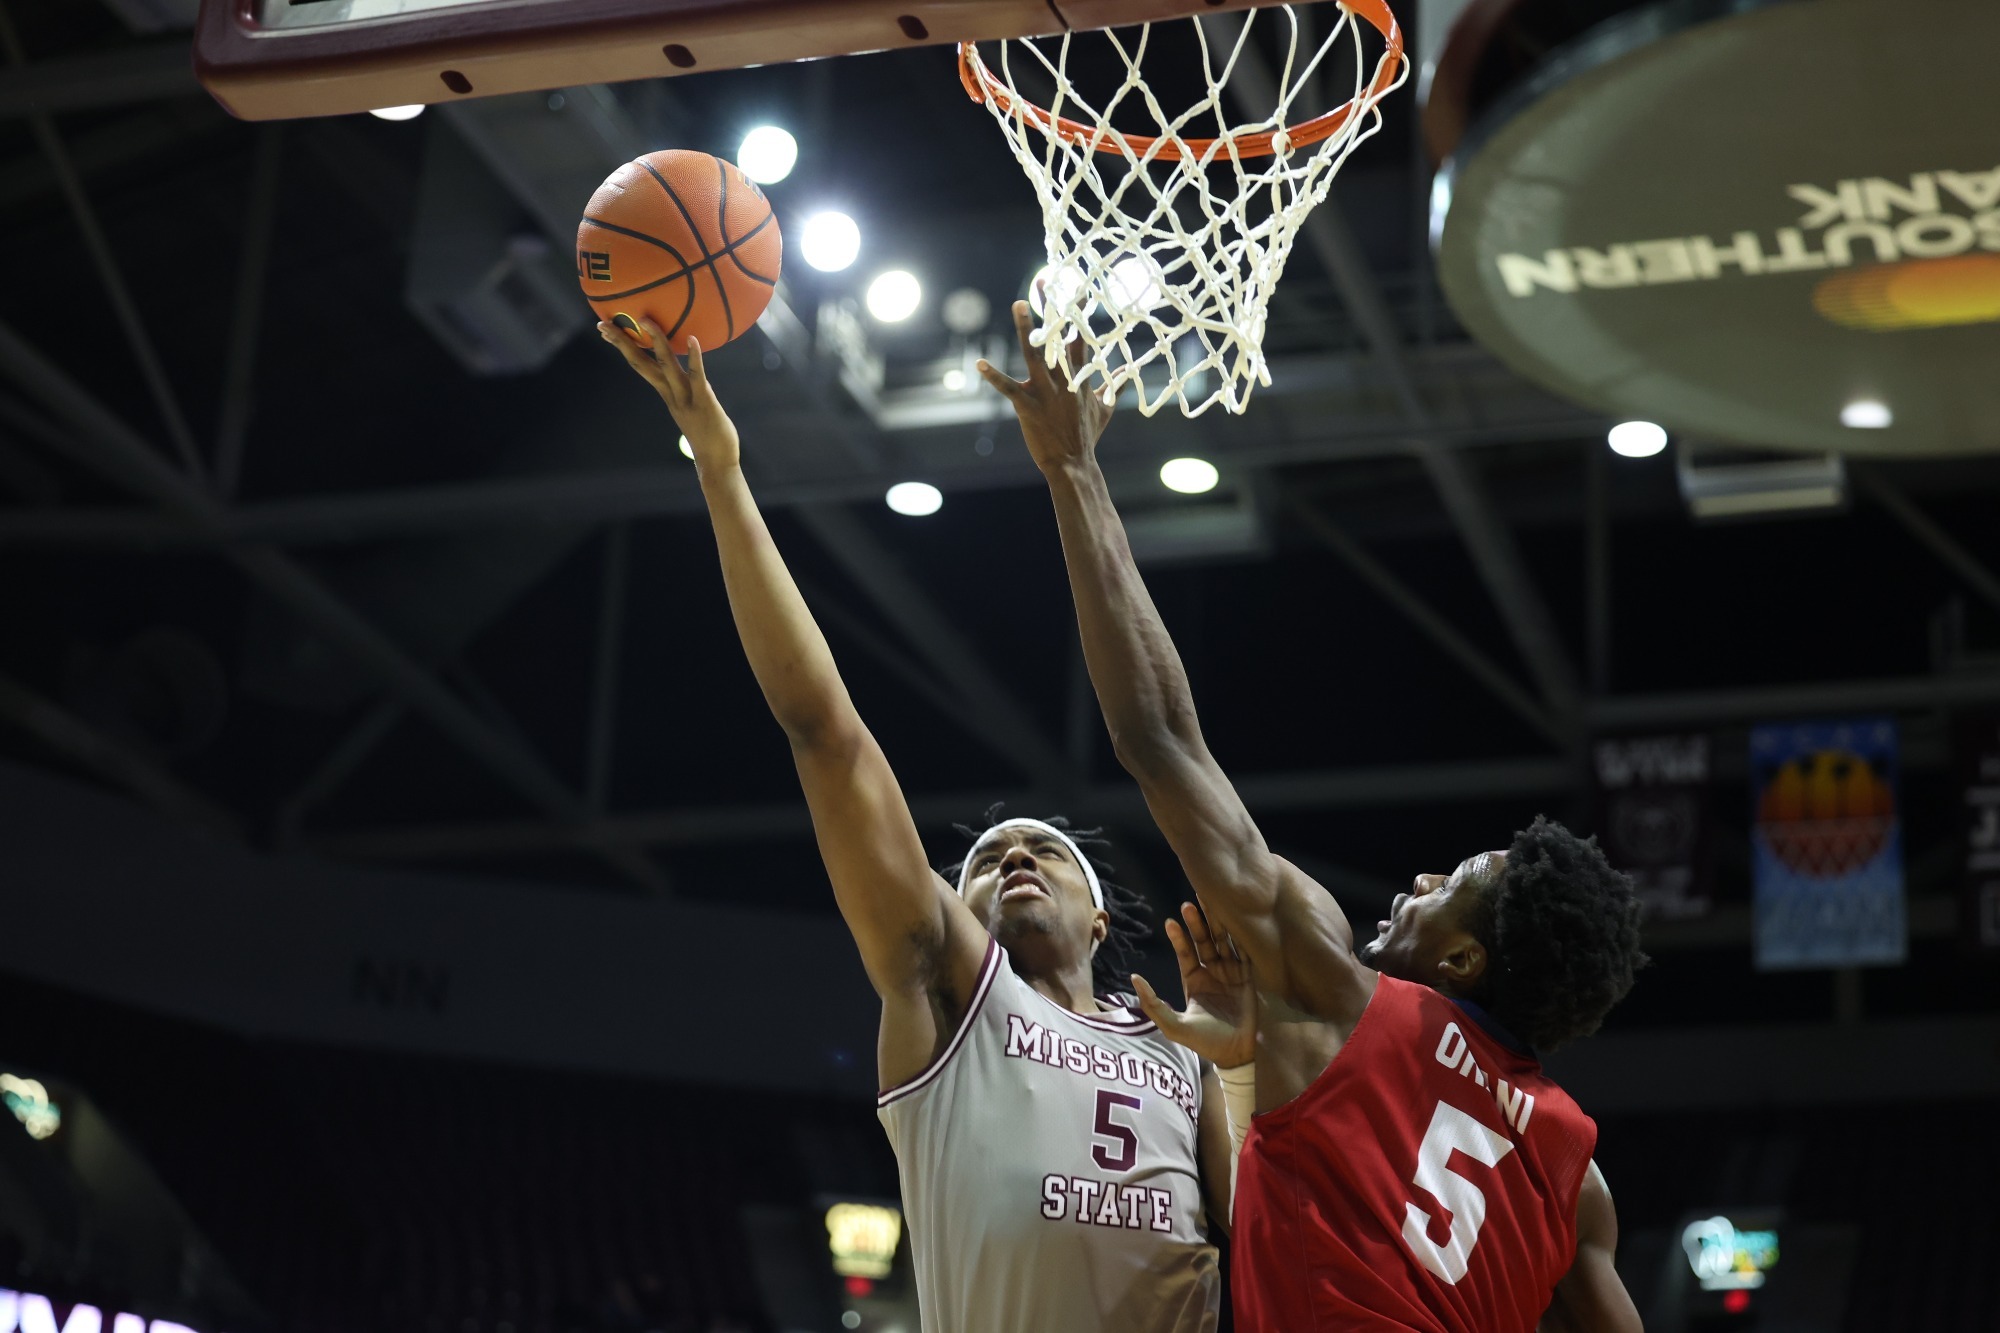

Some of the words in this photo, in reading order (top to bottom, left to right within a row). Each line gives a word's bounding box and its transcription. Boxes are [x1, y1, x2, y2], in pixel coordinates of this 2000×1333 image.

[1004, 1013, 1198, 1124] MISSOUR
[1090, 1086, 1143, 1175] 5
[1040, 1173, 1173, 1233] STATE
[1402, 1099, 1515, 1286] 5
